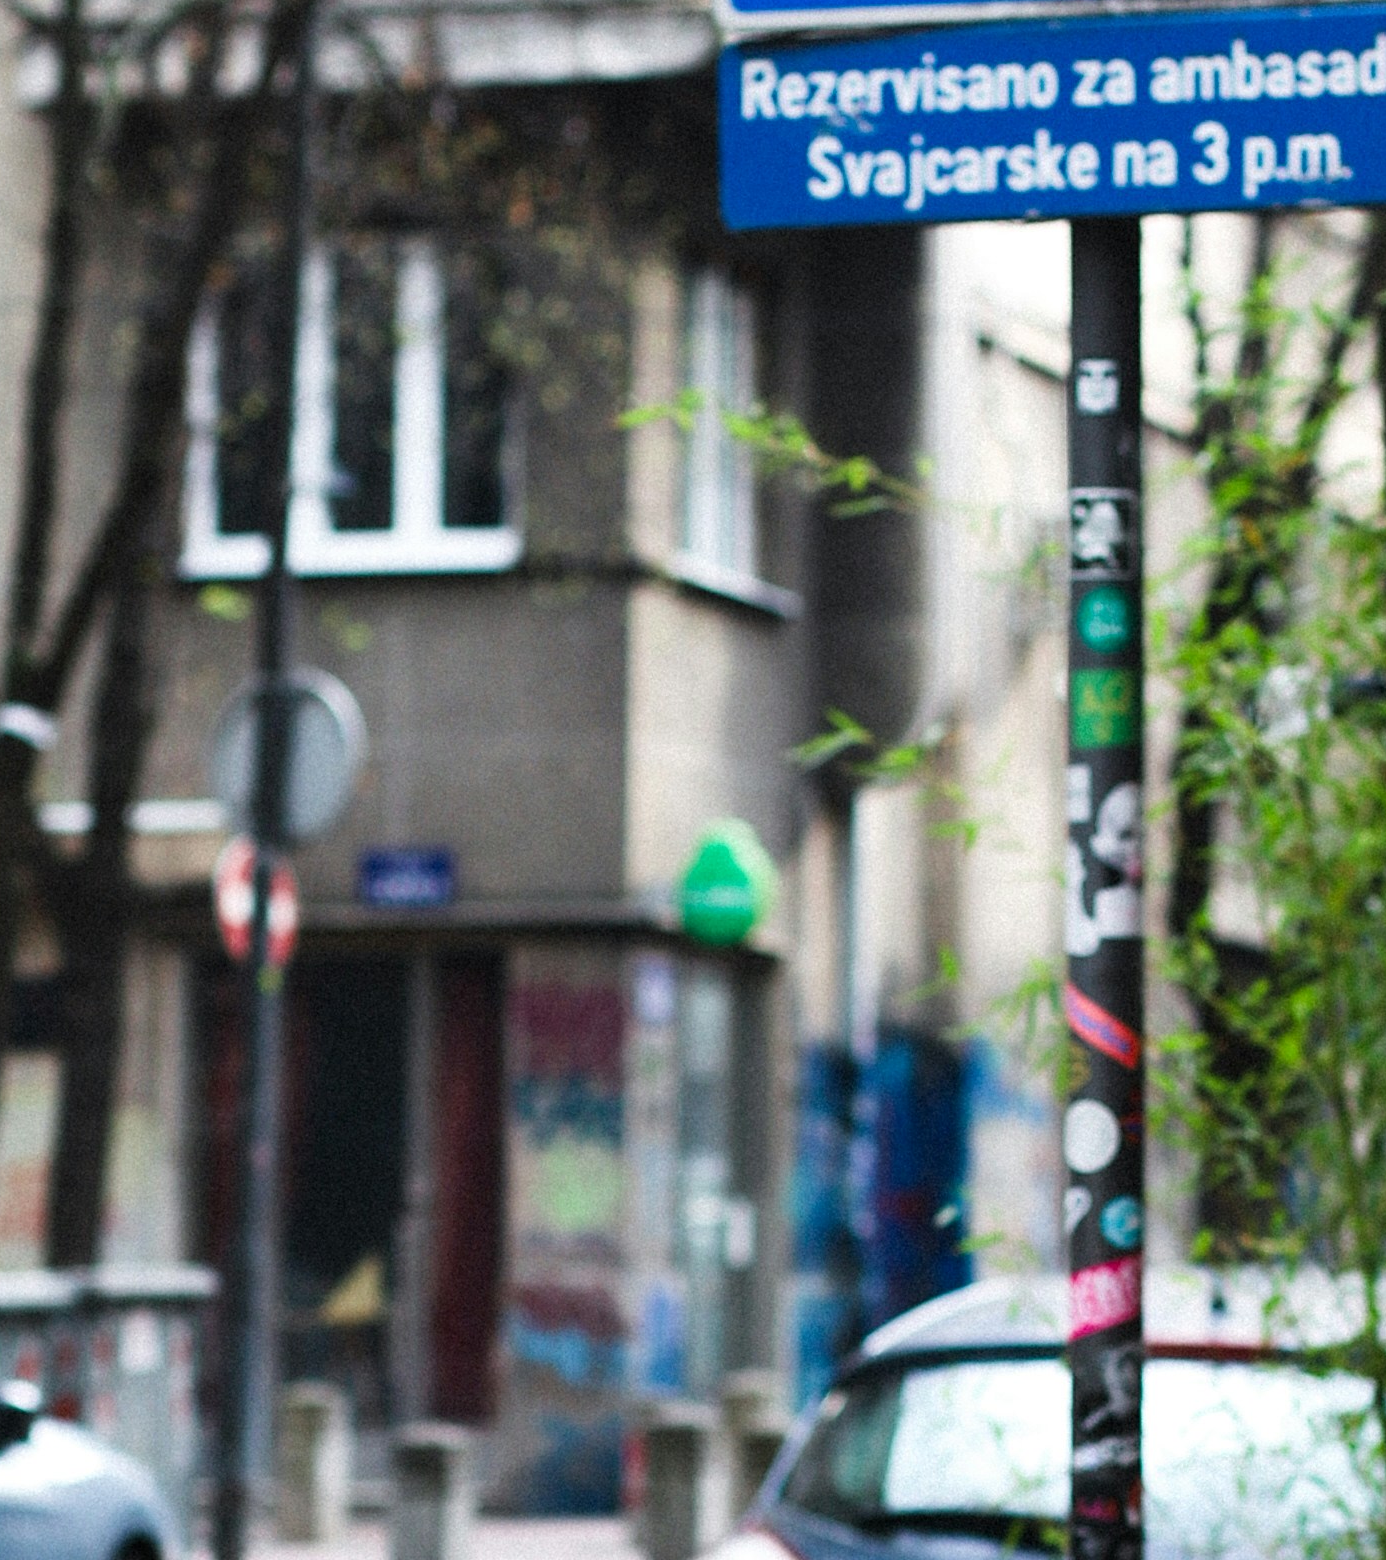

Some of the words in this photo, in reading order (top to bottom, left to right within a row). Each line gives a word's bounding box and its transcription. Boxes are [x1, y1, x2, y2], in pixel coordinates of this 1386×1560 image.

[739, 50, 1060, 122] Rezervisano
[1070, 56, 1138, 108] za
[806, 126, 1101, 212] Svajcarske
[1112, 137, 1179, 189] na
[1190, 118, 1231, 187] 3
[1240, 132, 1355, 200] p.m.
